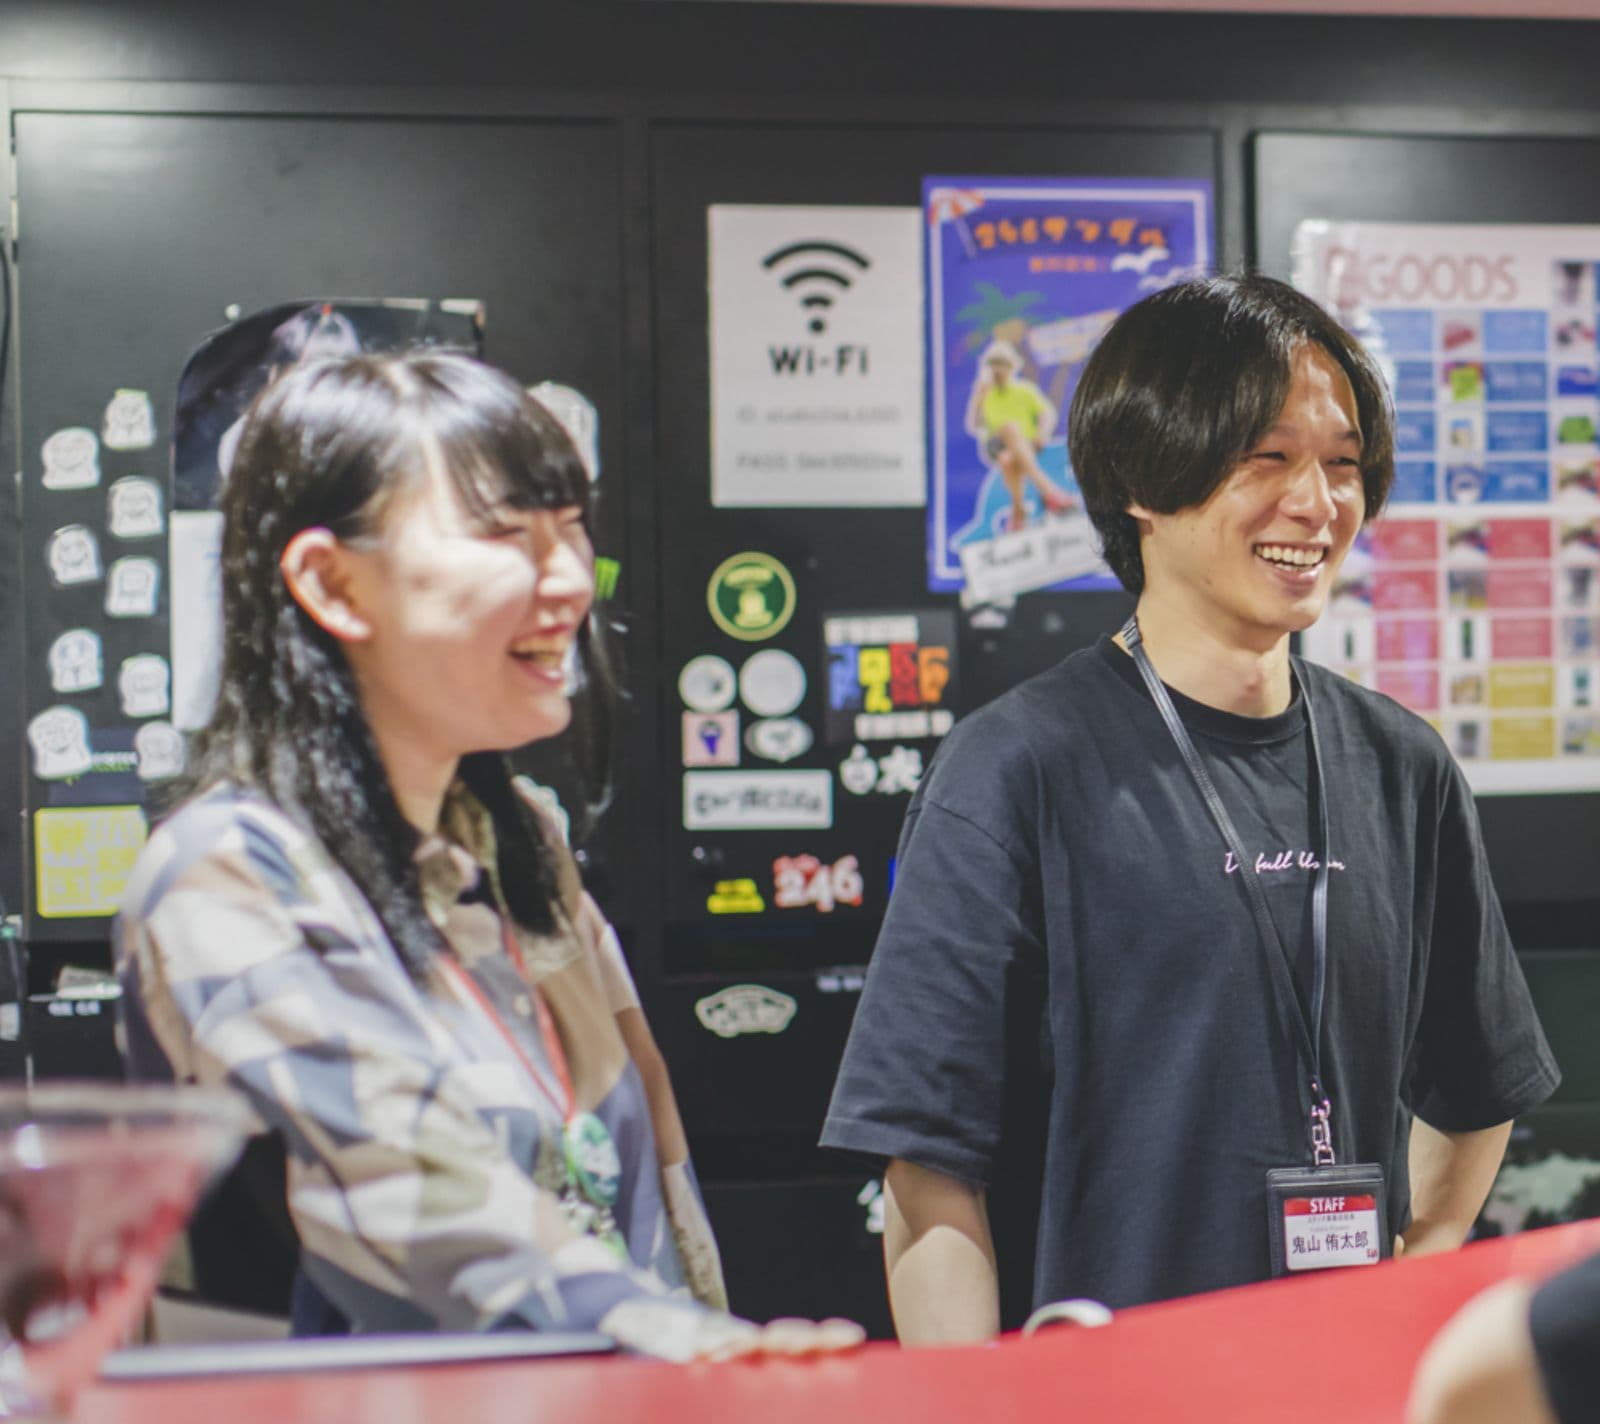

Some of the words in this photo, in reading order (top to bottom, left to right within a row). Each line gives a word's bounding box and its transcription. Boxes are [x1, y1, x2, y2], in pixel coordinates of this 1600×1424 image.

[1366, 252, 1520, 303] GOODS
[769, 344, 869, 375] Wi-Fi
[776, 855, 863, 912] 246
[1310, 1197, 1345, 1214] STAFF
[1292, 1235, 1321, 1254] 鬼山
